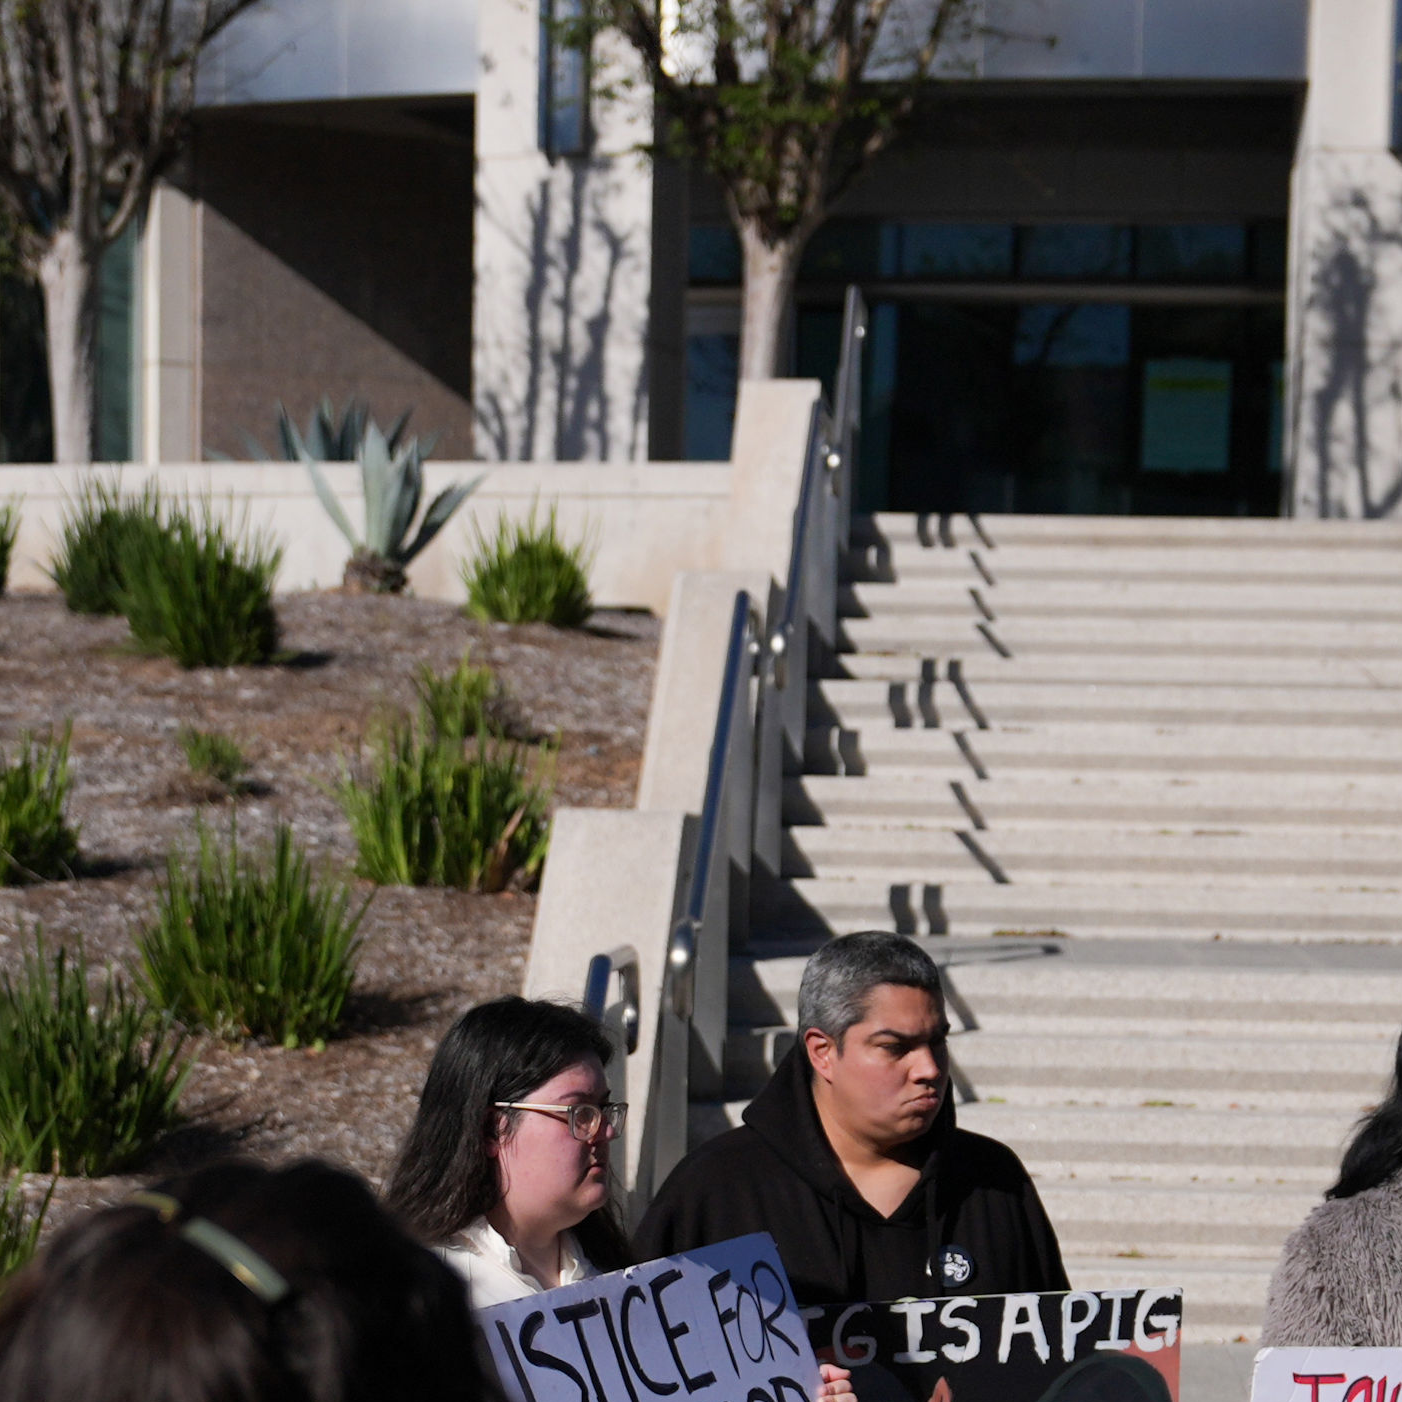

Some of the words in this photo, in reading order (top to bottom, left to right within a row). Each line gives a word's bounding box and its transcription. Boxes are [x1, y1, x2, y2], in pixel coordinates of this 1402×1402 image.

[708, 1259, 800, 1380] FOR
[888, 1296, 982, 1364] IS
[997, 1292, 1051, 1364] A
[1060, 1286, 1183, 1363] PIG
